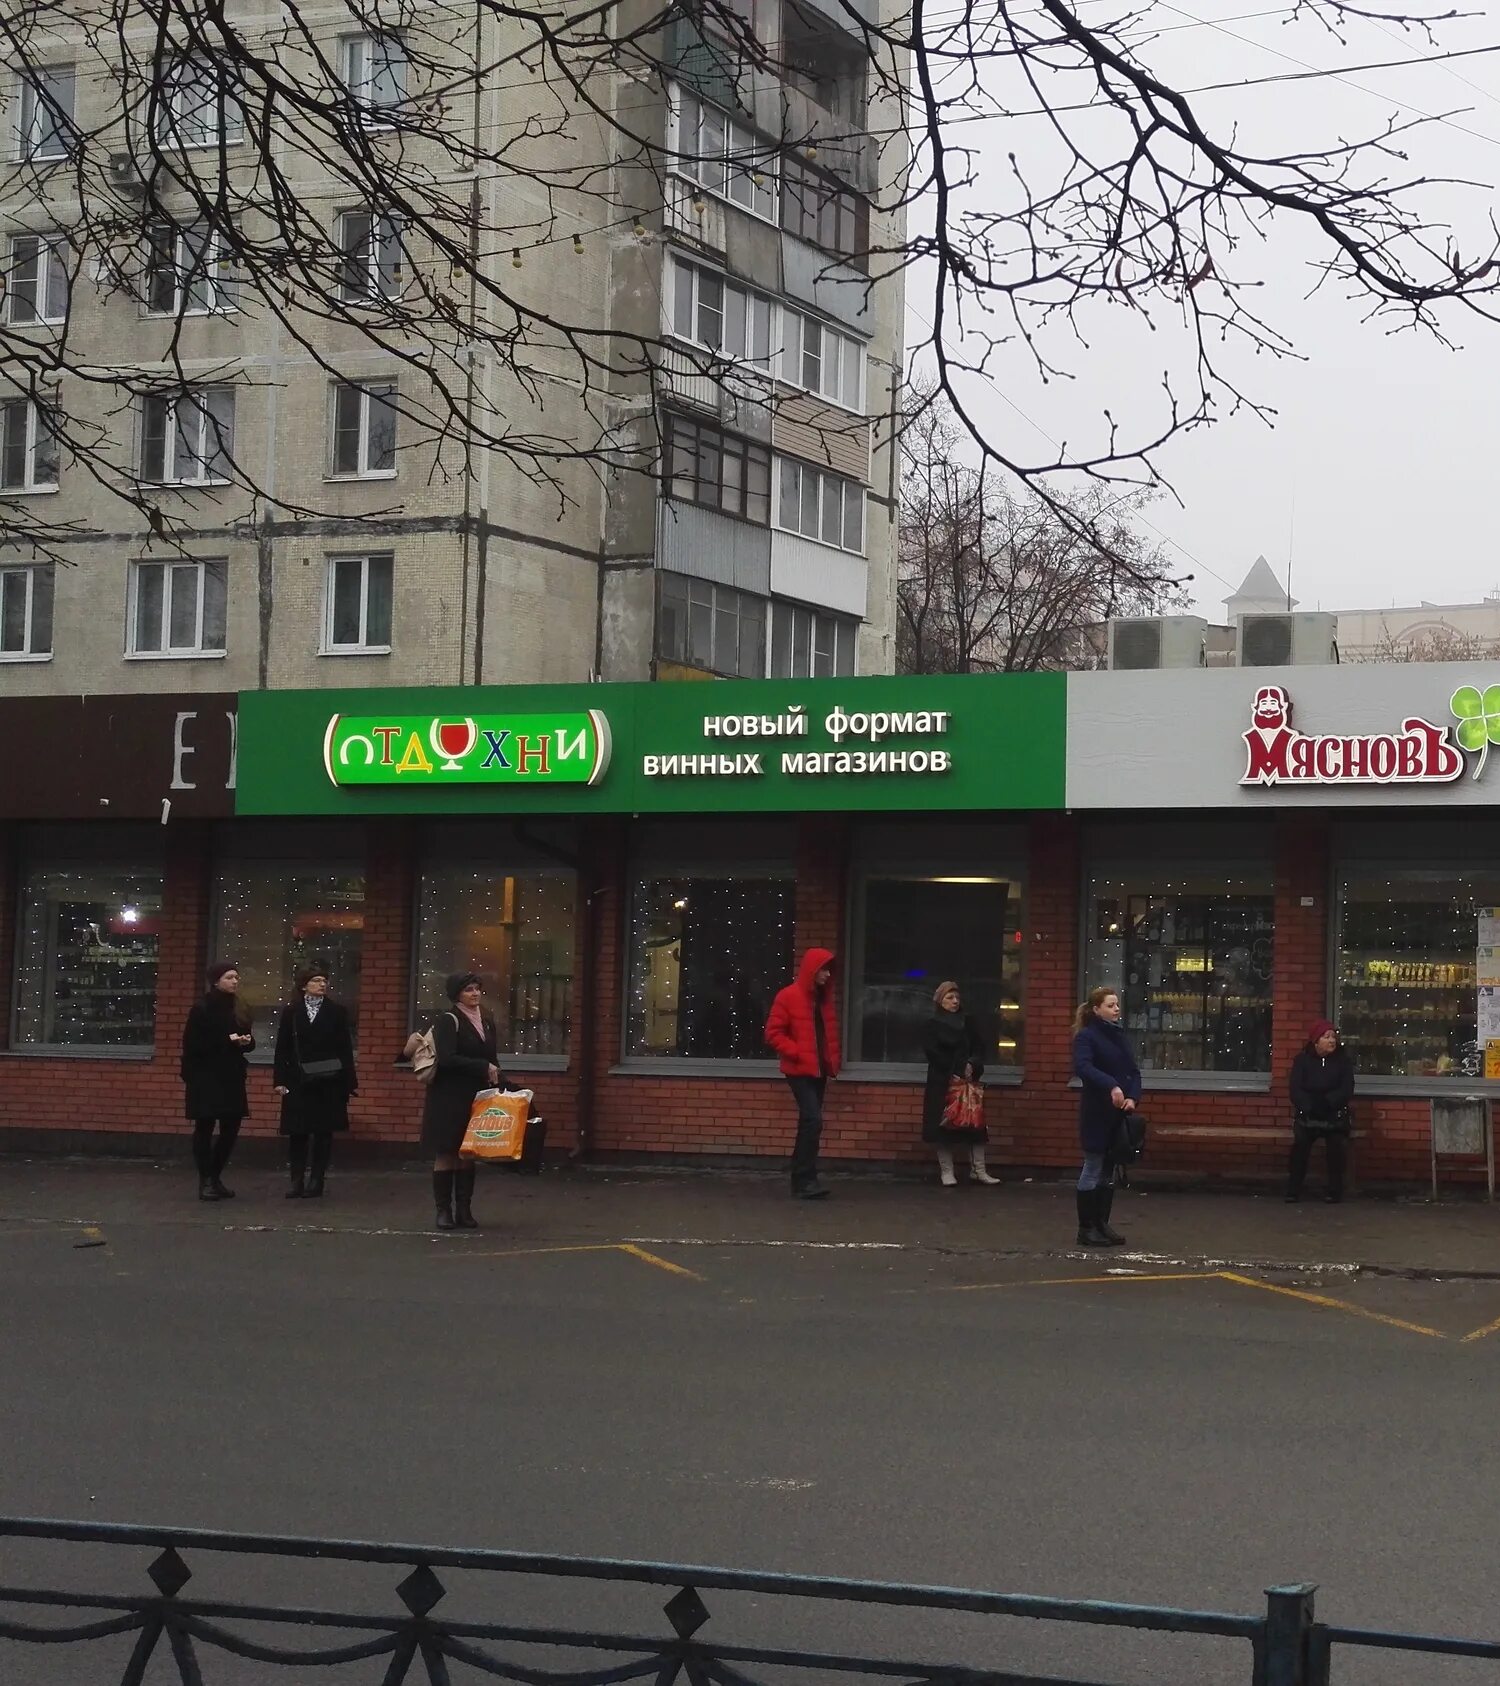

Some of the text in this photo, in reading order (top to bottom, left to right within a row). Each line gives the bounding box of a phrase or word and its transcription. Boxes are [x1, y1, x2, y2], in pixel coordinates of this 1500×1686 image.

[703, 705, 949, 743] новый формат
[643, 748, 950, 776] винных магазинов
